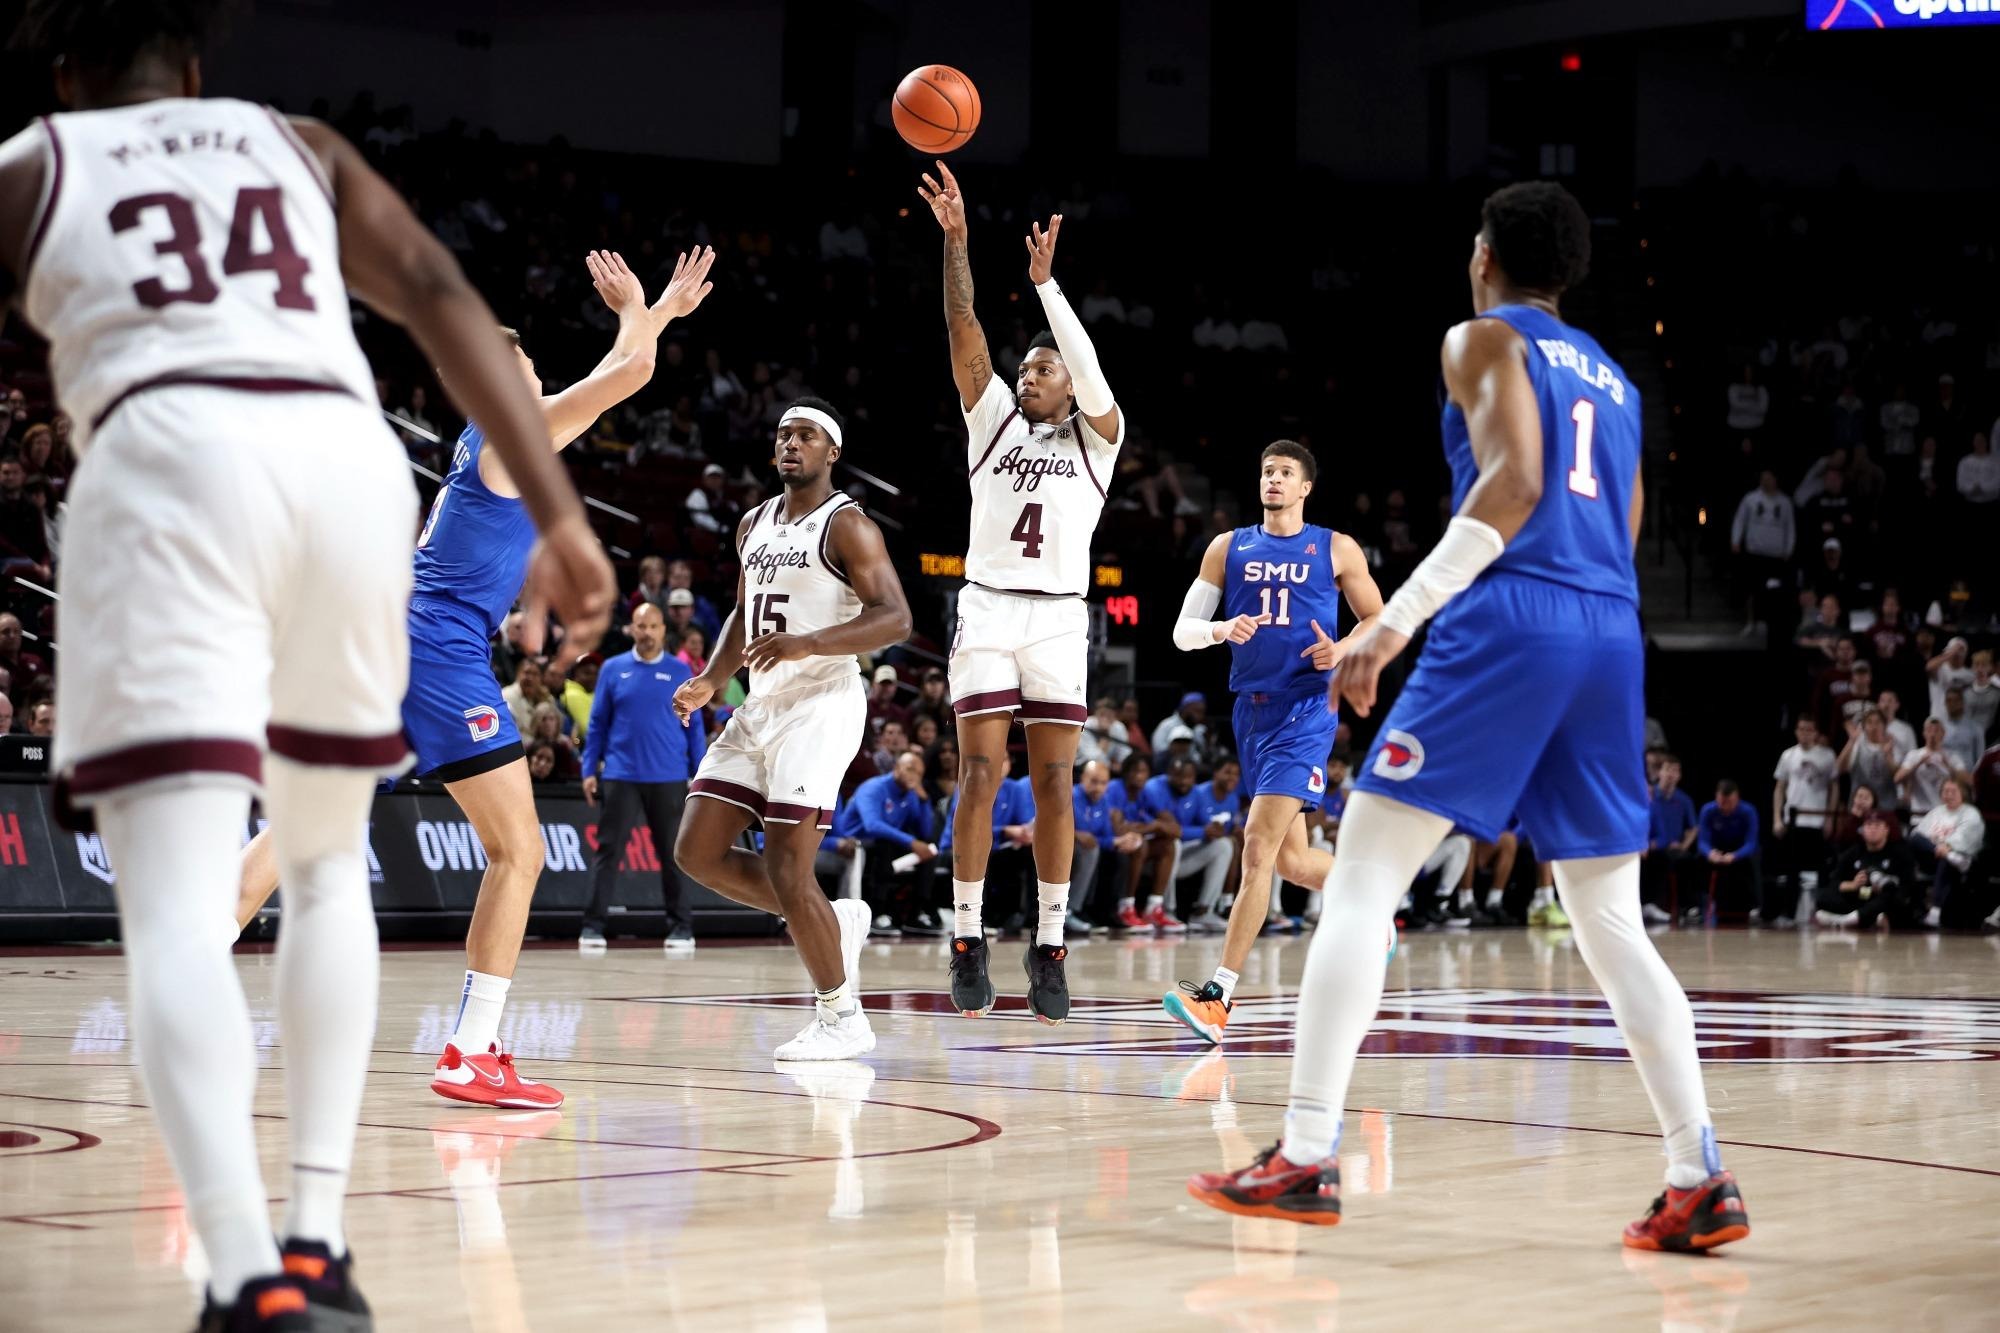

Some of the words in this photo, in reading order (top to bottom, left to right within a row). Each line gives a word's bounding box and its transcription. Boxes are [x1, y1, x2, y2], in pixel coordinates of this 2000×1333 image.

[108, 183, 317, 312] 34
[993, 446, 1078, 493] Aggies
[1568, 397, 1598, 499] 1
[1010, 502, 1044, 559] 4
[745, 543, 810, 585] Aggies
[1244, 561, 1310, 584] SMU
[752, 593, 790, 641] 15
[1107, 596, 1138, 625] 49
[1258, 587, 1290, 626] 11
[22, 747, 43, 760] POSS
